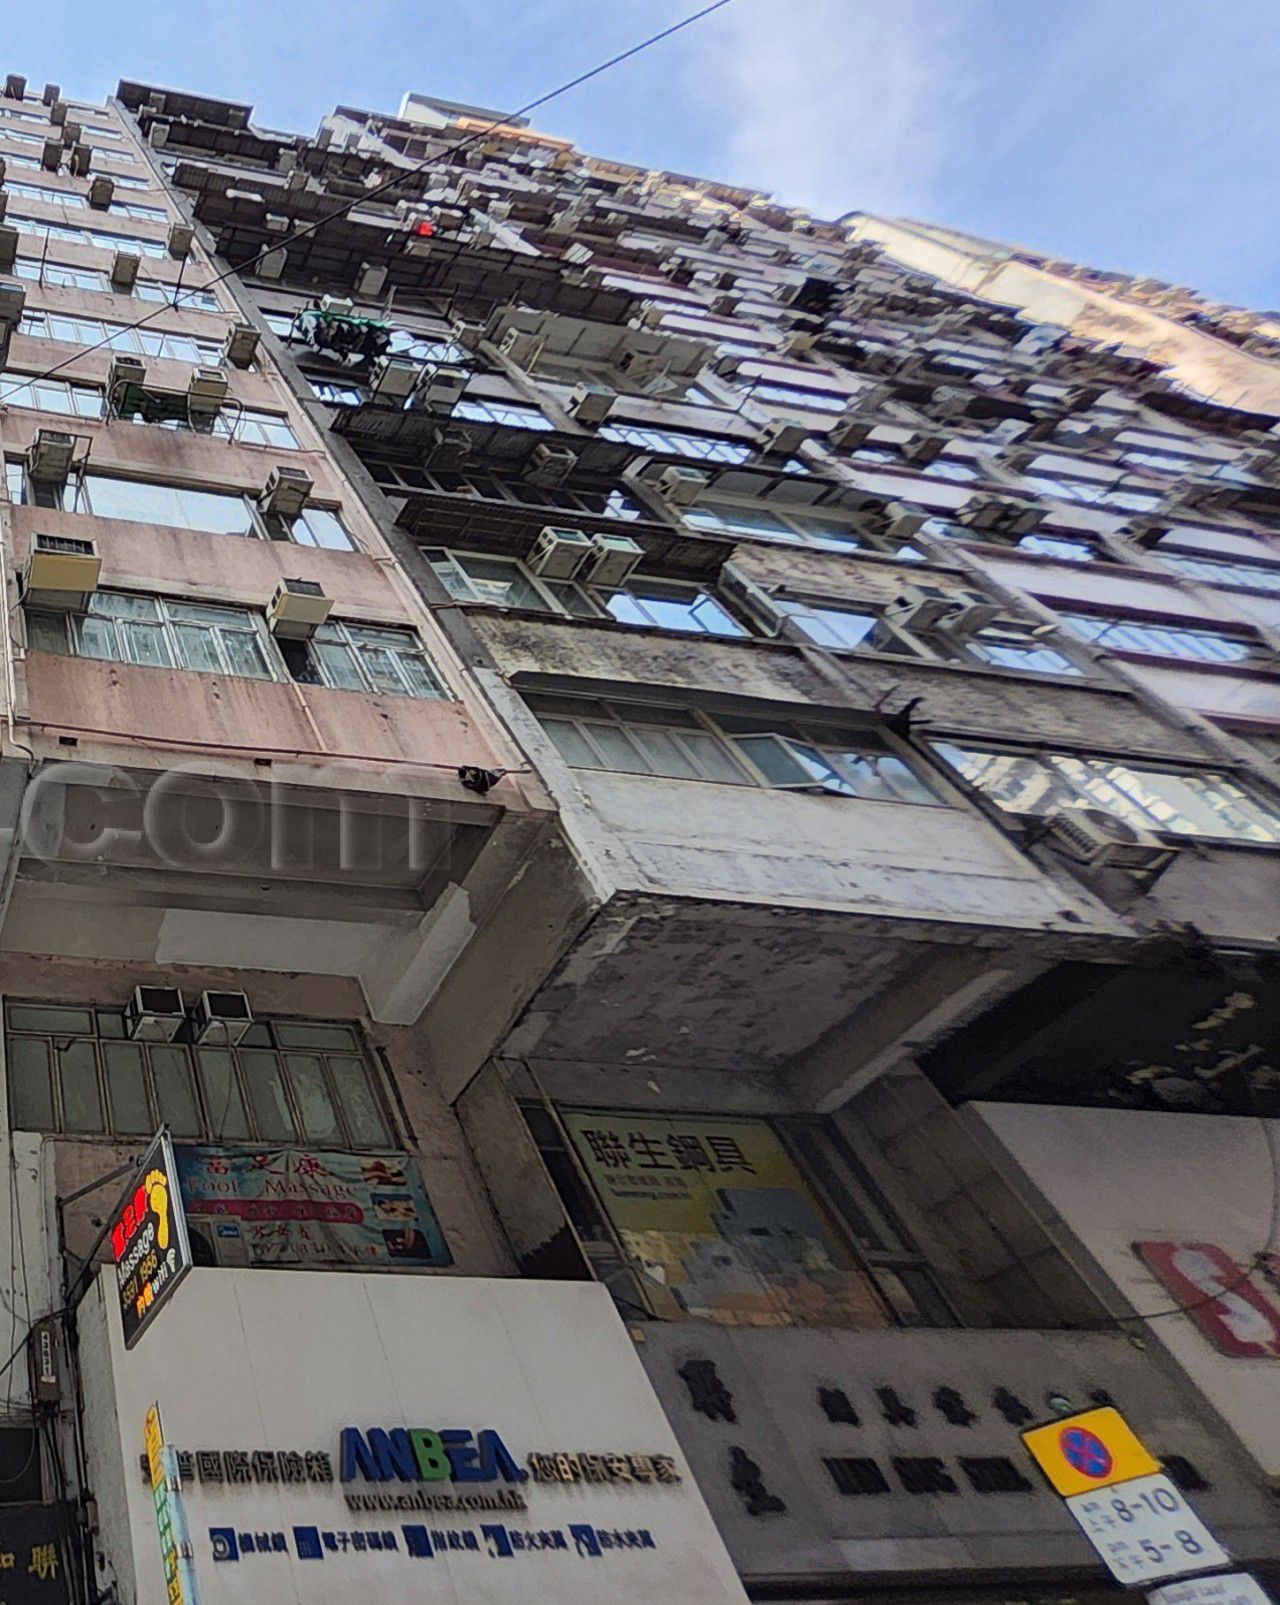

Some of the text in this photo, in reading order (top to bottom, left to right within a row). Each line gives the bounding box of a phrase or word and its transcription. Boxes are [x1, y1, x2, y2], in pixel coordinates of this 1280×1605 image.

[186, 1177, 358, 1199] Foot Massage
[339, 1427, 524, 1483] ANBEA
[1111, 1487, 1180, 1524] 8-10
